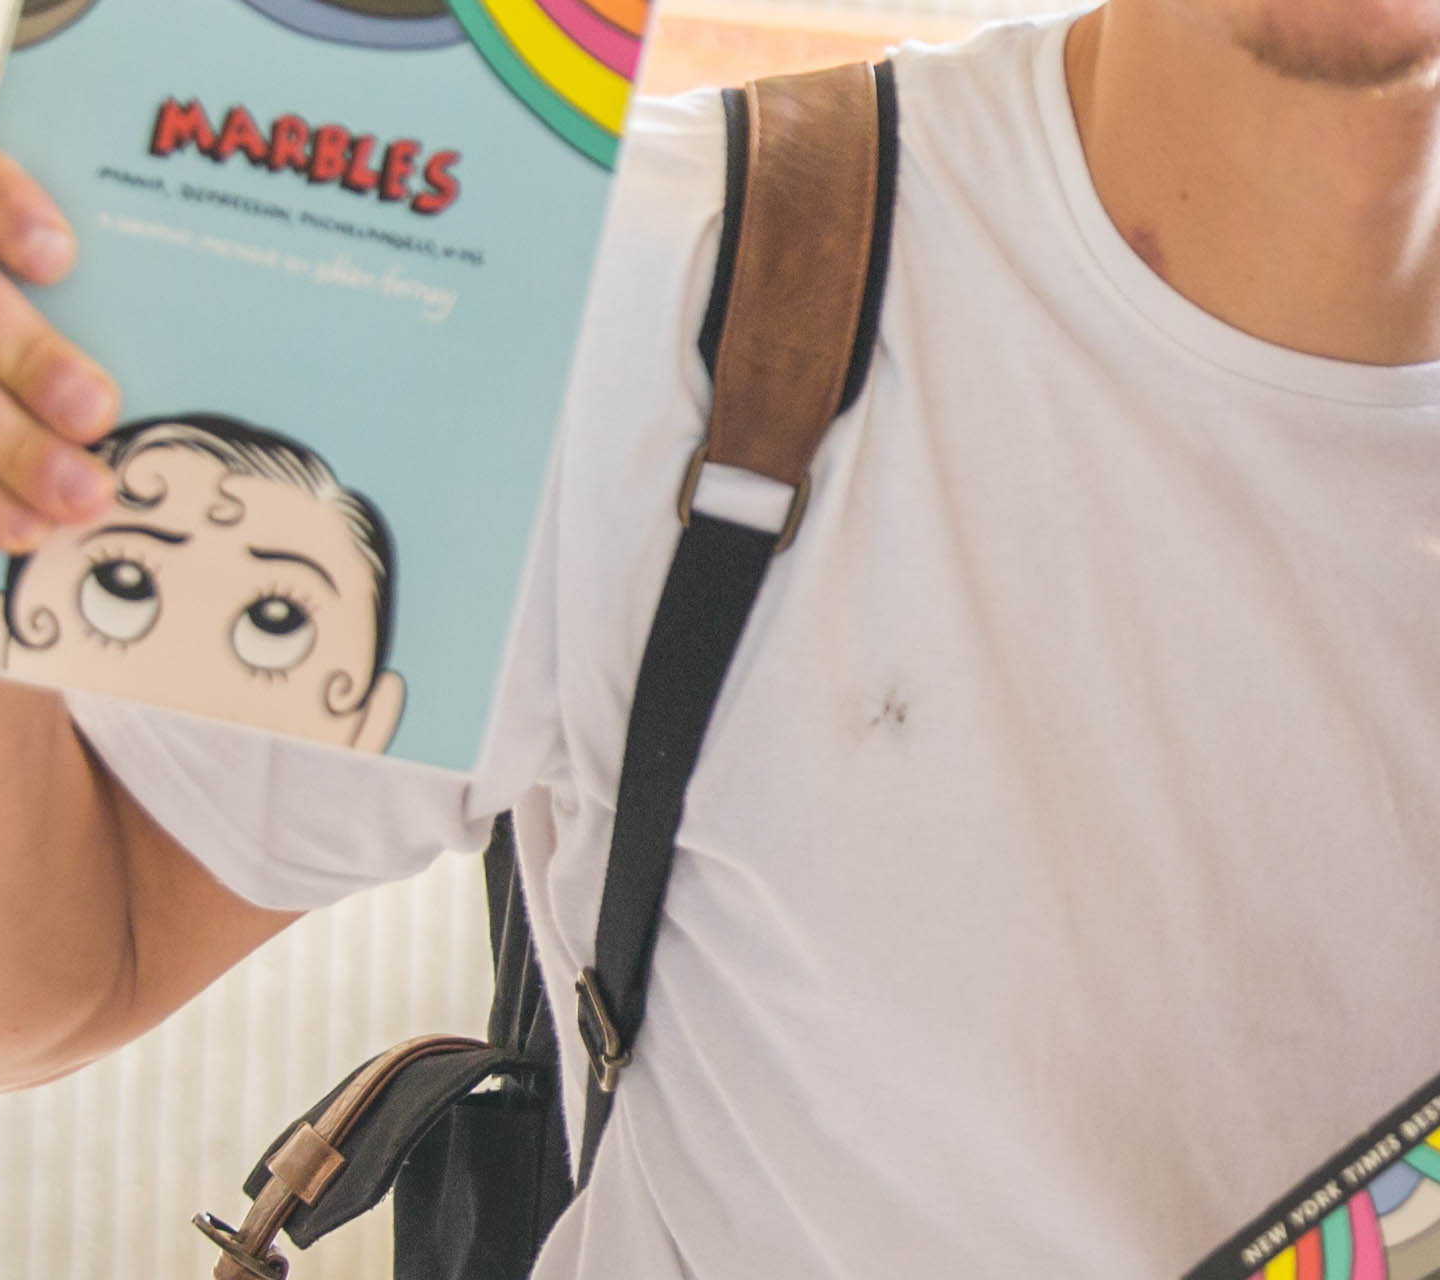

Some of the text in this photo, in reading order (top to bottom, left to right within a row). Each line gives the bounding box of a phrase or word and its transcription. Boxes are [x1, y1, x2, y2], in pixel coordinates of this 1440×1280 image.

[148, 95, 462, 215] MARBLES
[1241, 1222, 1288, 1265] NEW
[1288, 1179, 1341, 1228] YORK
[1341, 1133, 1401, 1185] TIMES
